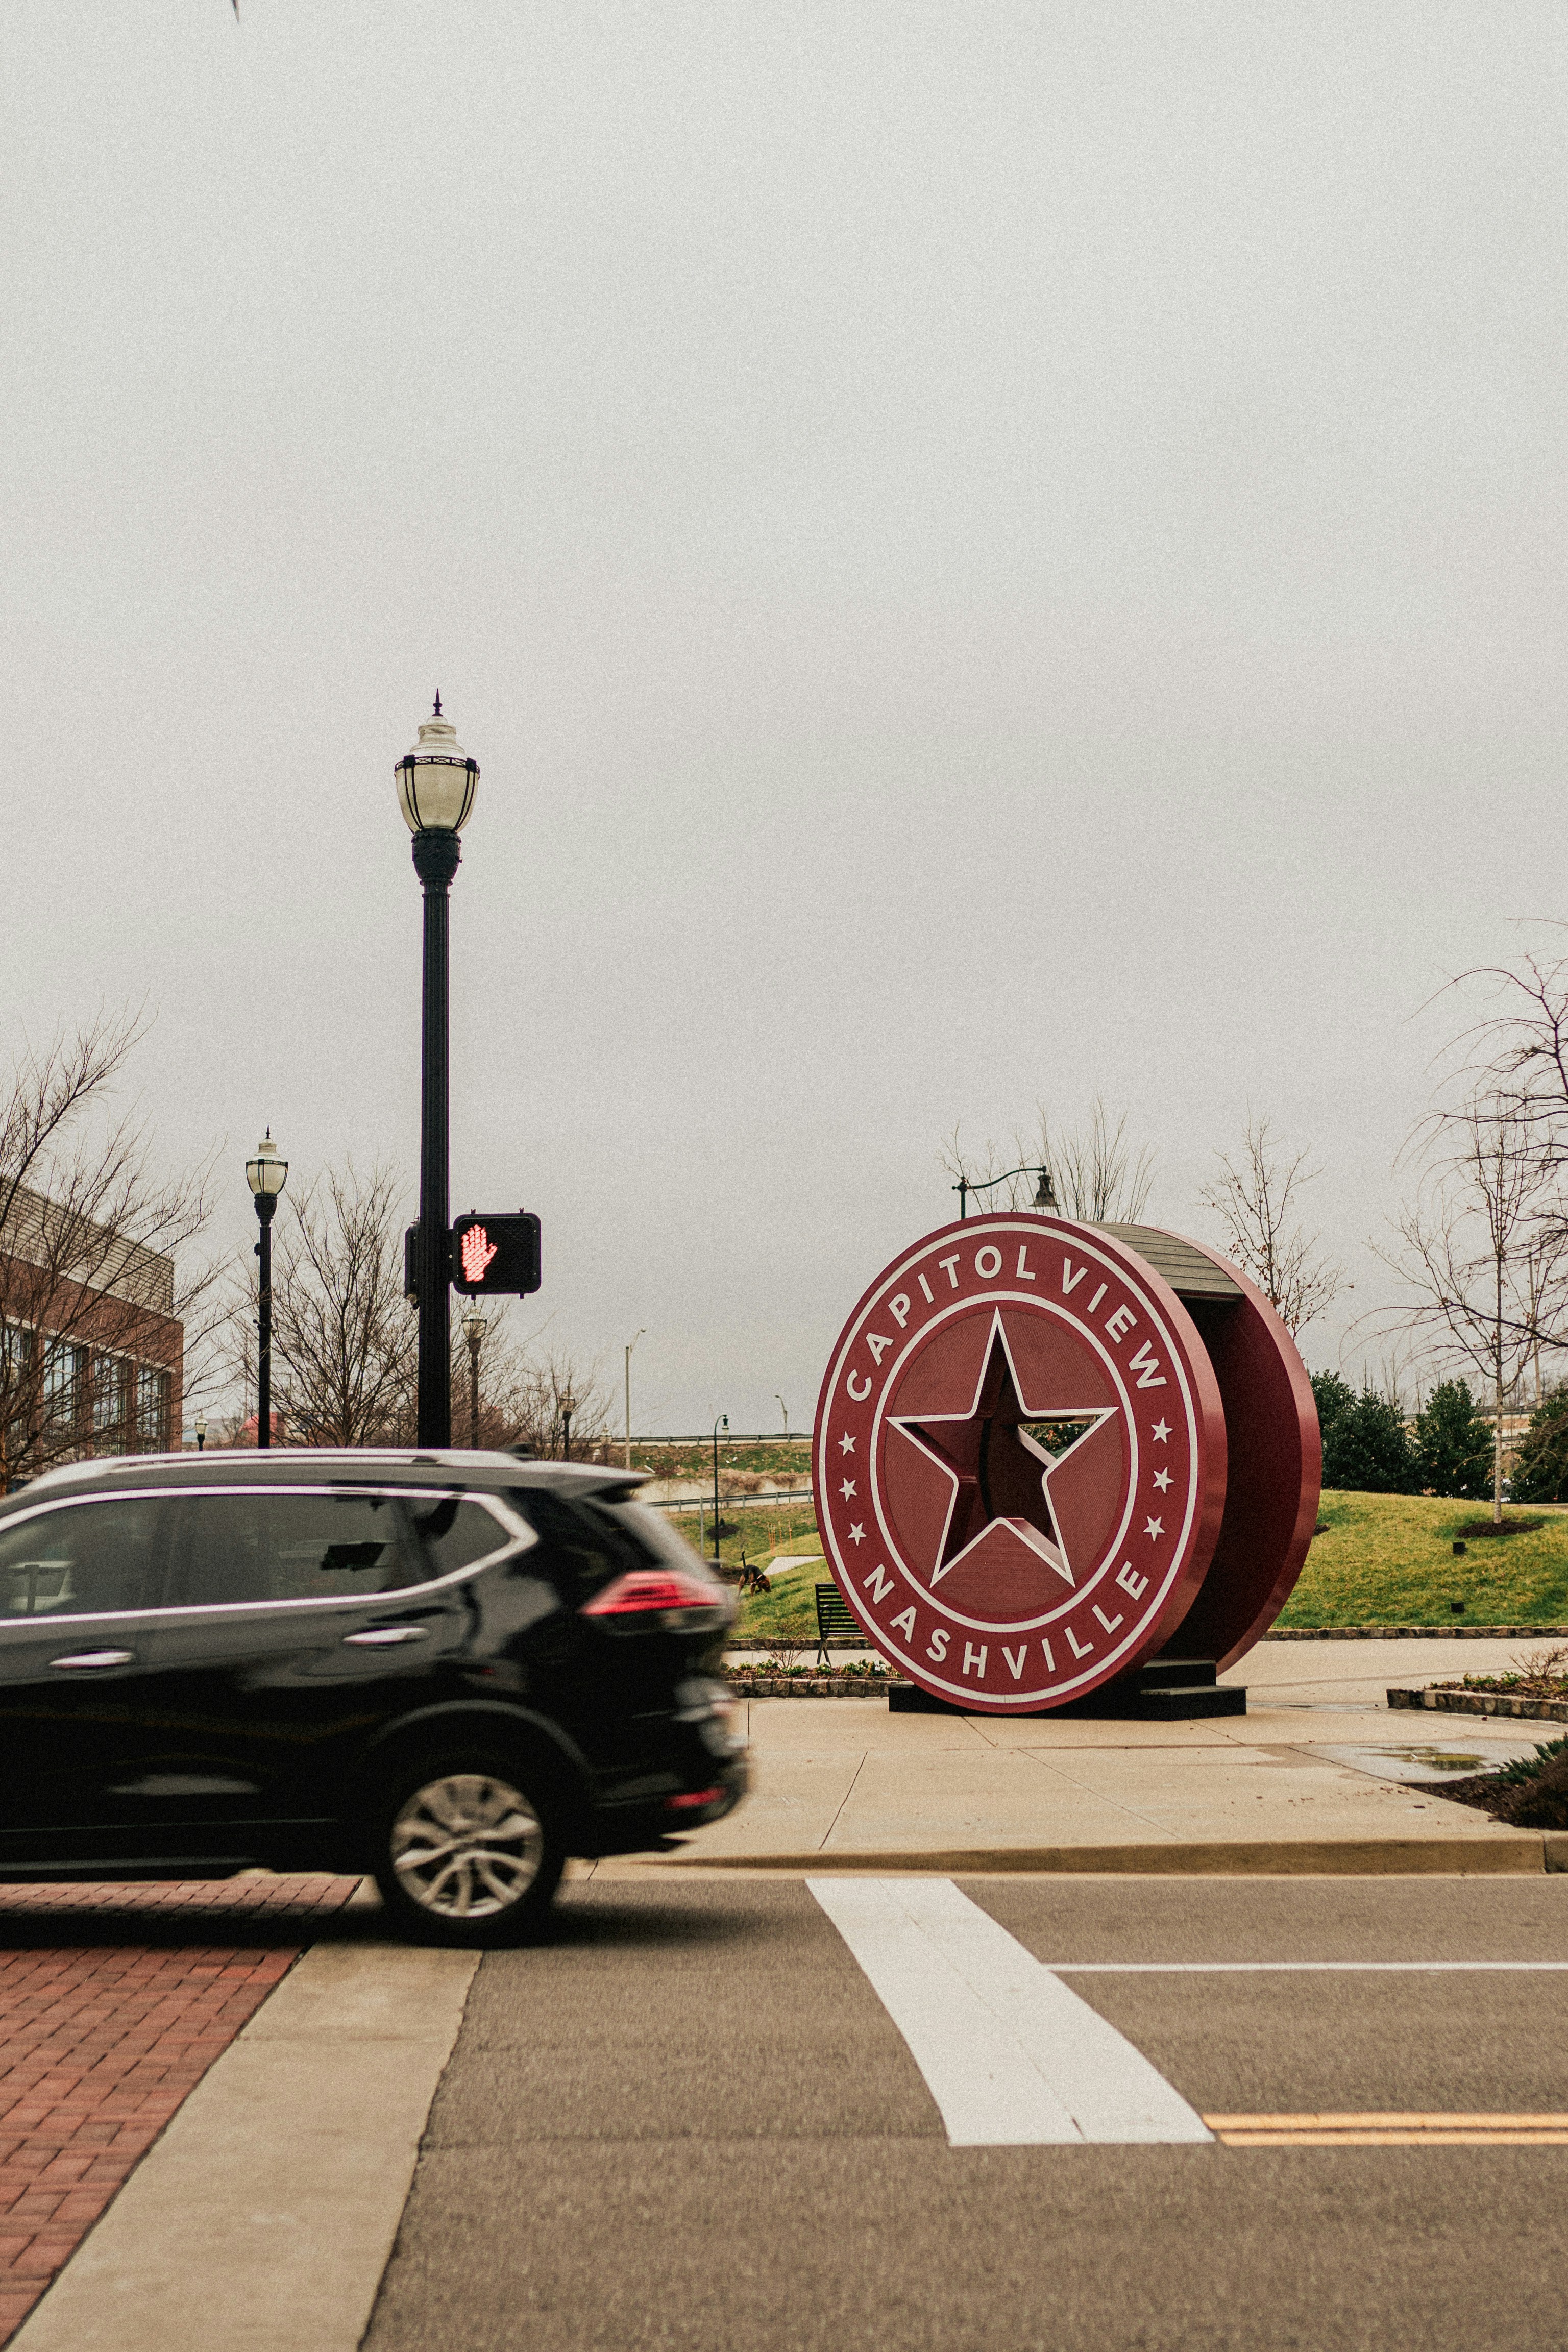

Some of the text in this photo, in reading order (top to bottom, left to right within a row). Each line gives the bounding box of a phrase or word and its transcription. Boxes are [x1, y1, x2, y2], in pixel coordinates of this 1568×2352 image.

[846, 1245, 1167, 1402] CAPITOL VIEW
[863, 1560, 1149, 1680] NASHVILLE
